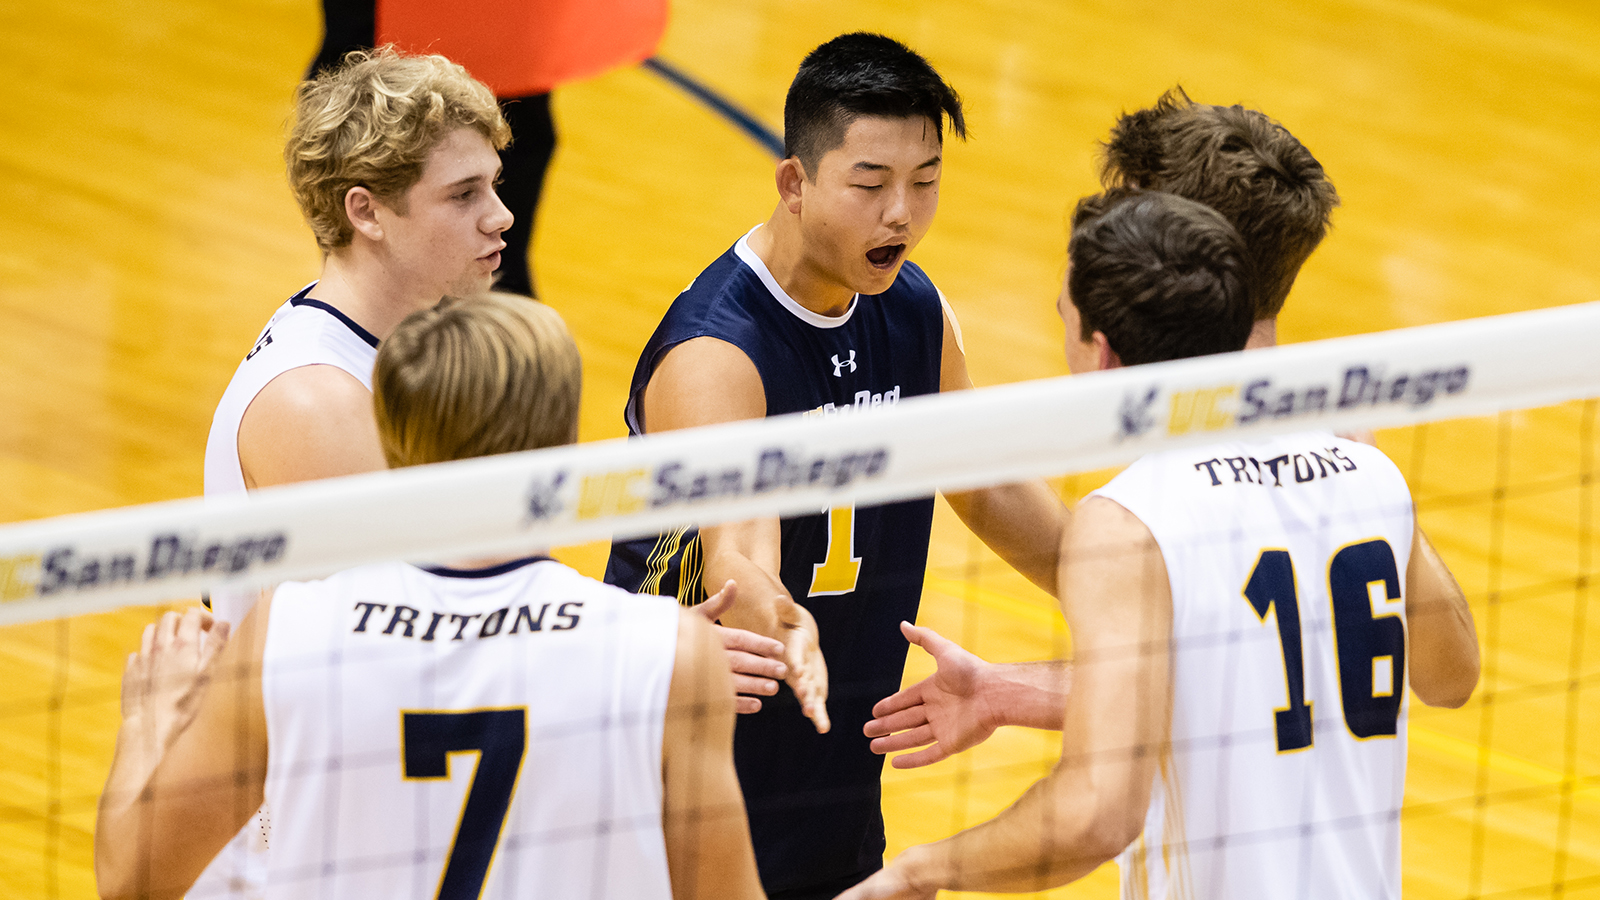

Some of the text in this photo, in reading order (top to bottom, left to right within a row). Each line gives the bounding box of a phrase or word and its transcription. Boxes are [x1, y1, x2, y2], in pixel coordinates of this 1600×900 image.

[1167, 384, 1238, 437] UC
[1194, 446, 1358, 487] TRITONS
[577, 467, 649, 521] UC
[353, 601, 584, 642] TRITONS
[1241, 536, 1407, 756] 16
[399, 704, 530, 900] 7
